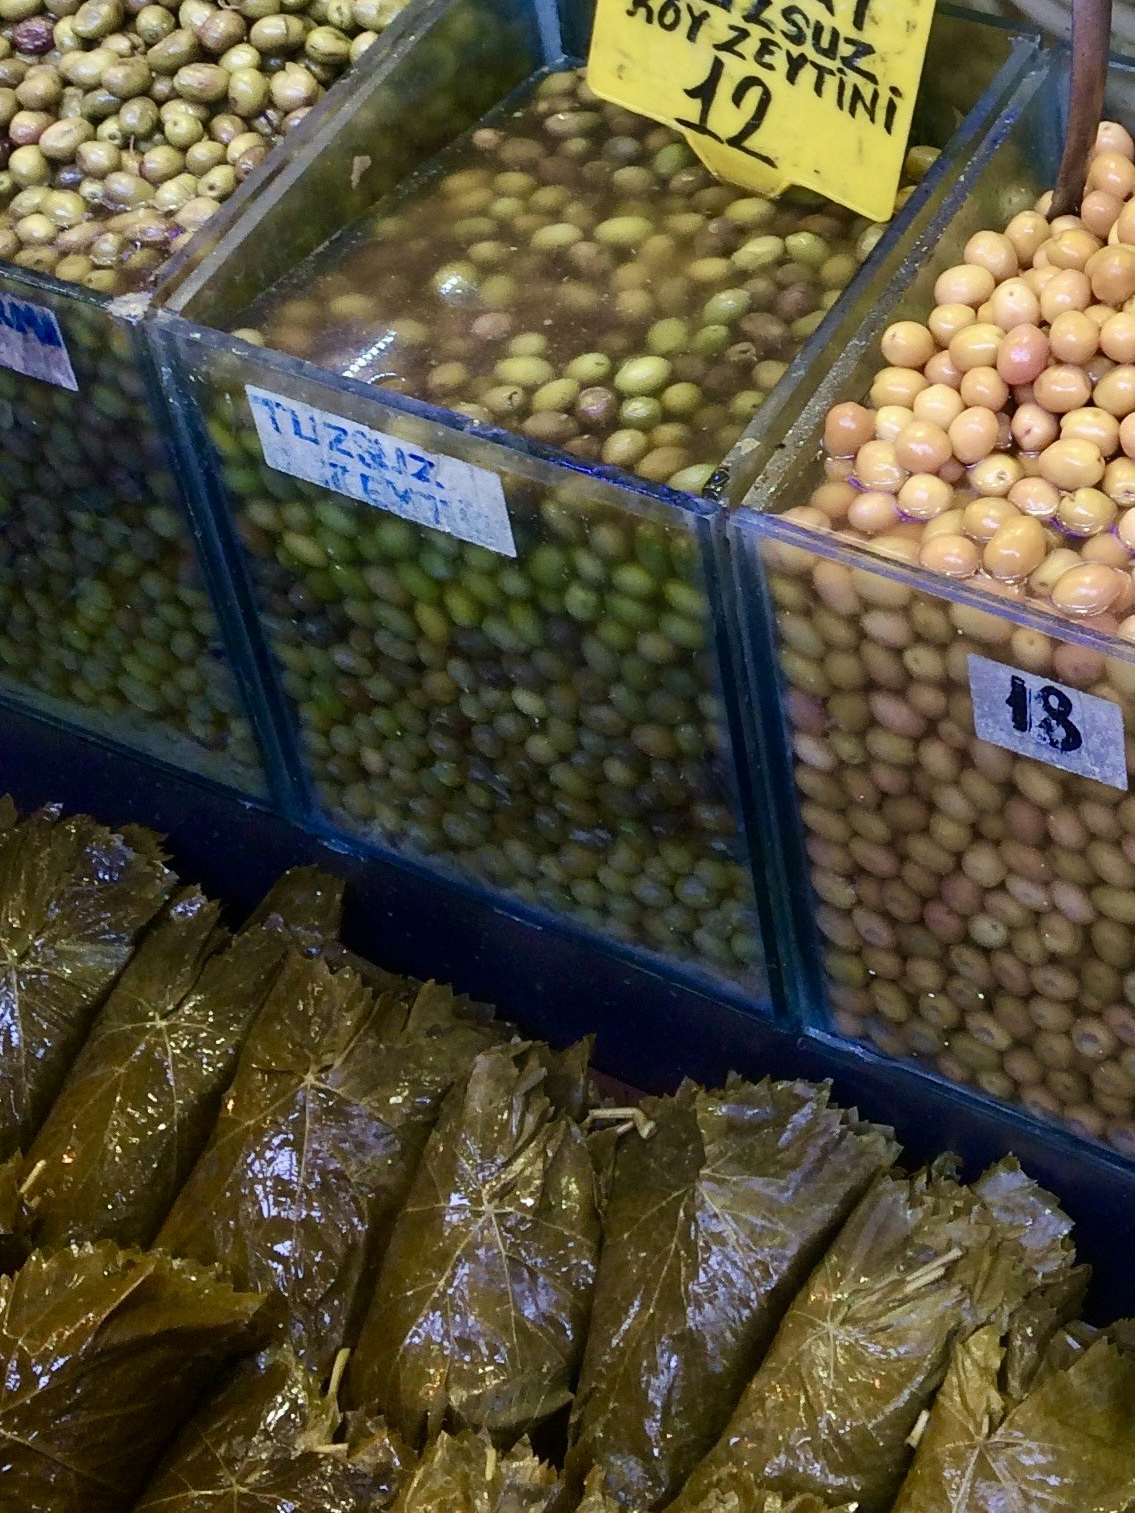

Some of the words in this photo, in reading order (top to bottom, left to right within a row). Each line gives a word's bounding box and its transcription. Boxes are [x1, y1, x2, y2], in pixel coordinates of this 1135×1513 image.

[674, 55, 778, 169] 12
[712, 24, 904, 136] ZEYTİNİ
[1005, 674, 1083, 753] 18
